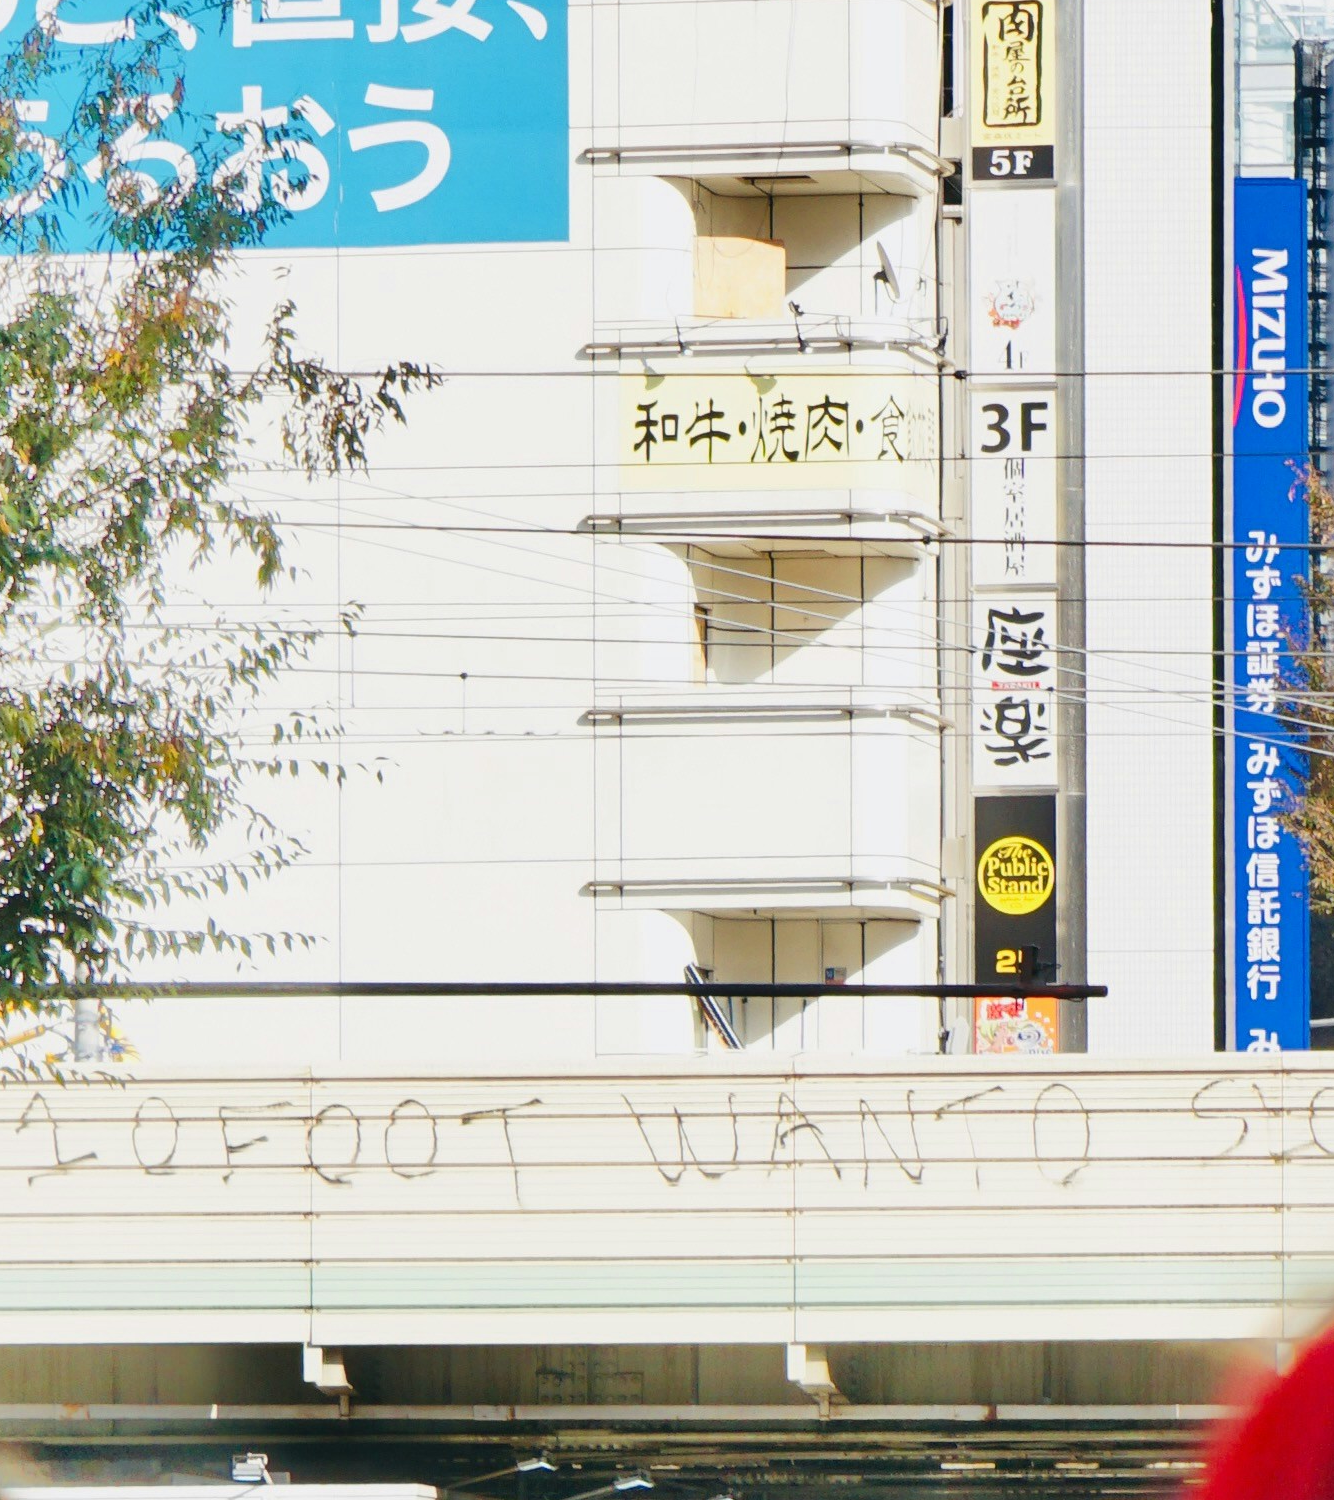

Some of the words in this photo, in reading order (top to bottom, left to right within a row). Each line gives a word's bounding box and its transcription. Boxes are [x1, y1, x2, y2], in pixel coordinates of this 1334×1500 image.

[994, 3, 1035, 123] 肉屋の台所
[989, 150, 1034, 176] 5F
[1252, 247, 1289, 429] MIZUHO
[980, 401, 1048, 453] 3F
[1245, 531, 1281, 713] みずほ証券
[986, 856, 1049, 877] Public
[997, 843, 1033, 859] The
[986, 876, 1045, 895] Stand
[1246, 743, 1282, 1001] みずほ信託銀行
[996, 949, 1023, 974] 2
